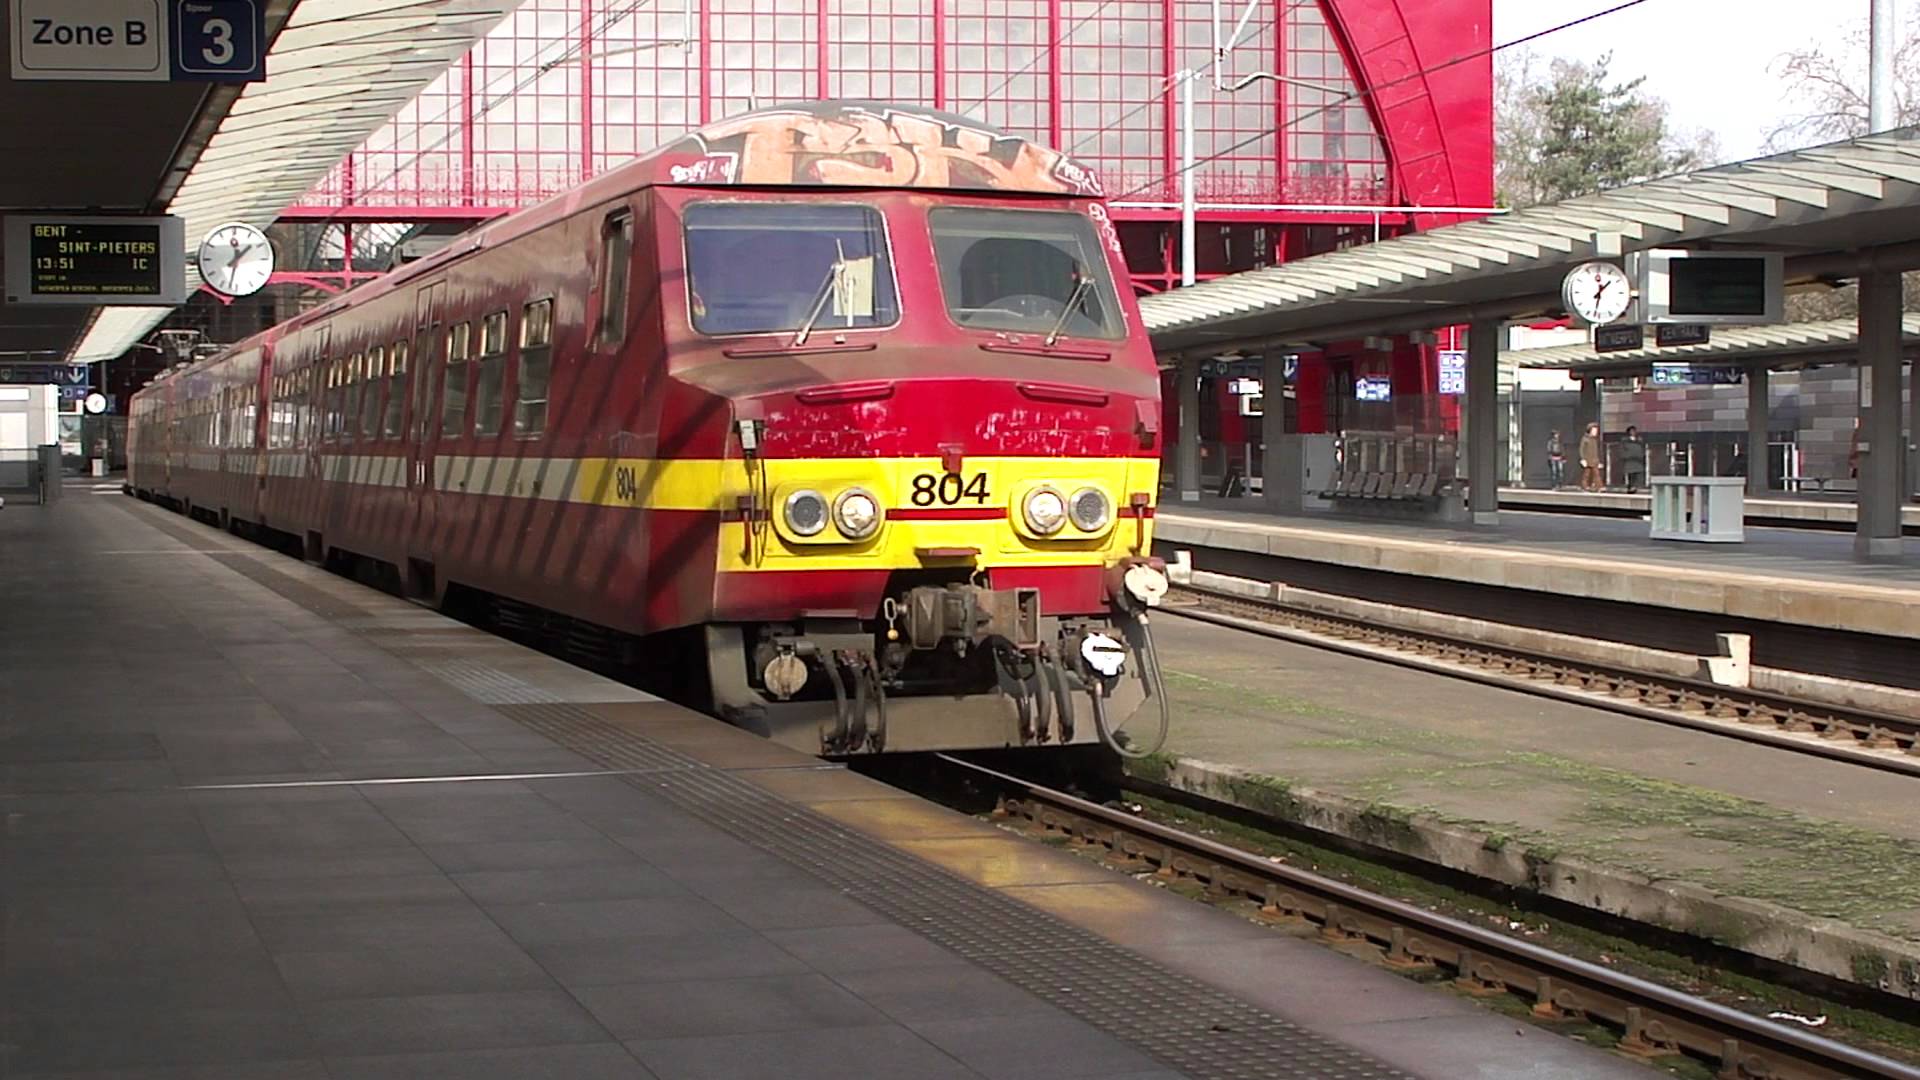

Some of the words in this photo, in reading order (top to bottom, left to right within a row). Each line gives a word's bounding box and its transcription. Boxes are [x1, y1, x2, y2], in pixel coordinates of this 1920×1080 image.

[32, 19, 114, 46] Zone
[125, 20, 147, 46] B
[202, 18, 235, 65] 3
[58, 241, 156, 254] SINT-PIETERS
[37, 257, 75, 270] 13:51
[133, 258, 148, 270] IC
[616, 466, 636, 501] 804
[911, 472, 991, 507] 804
